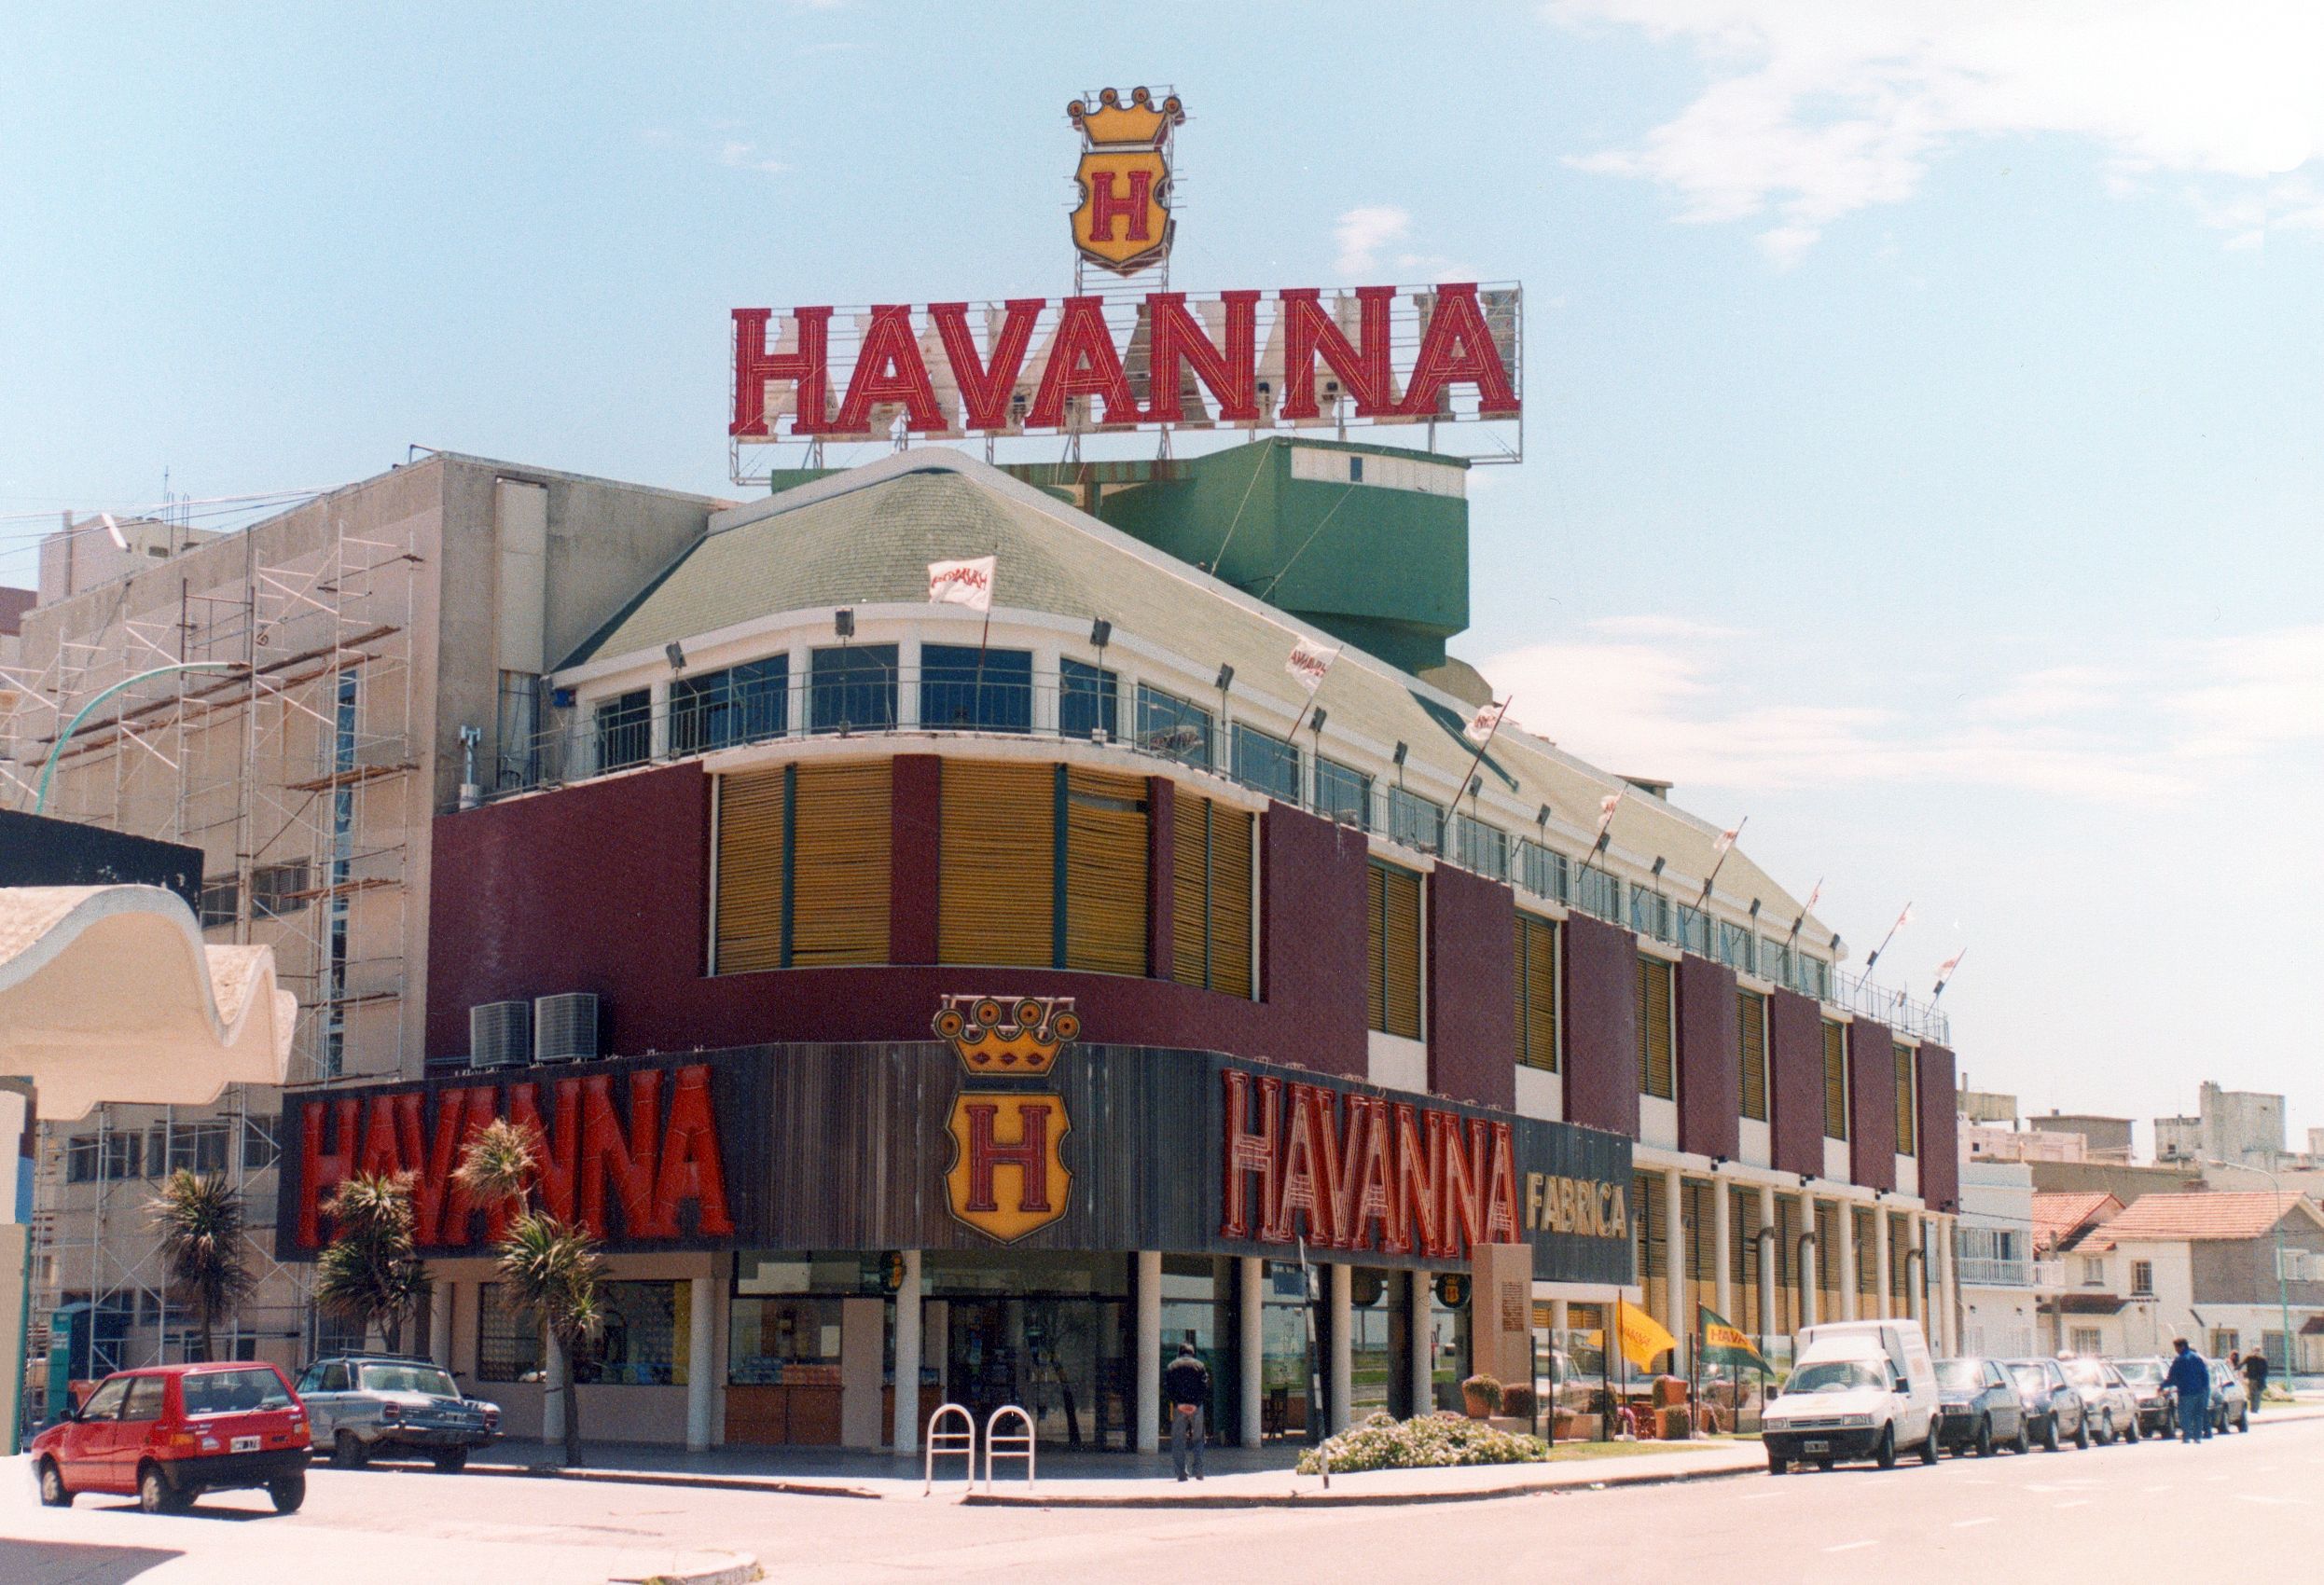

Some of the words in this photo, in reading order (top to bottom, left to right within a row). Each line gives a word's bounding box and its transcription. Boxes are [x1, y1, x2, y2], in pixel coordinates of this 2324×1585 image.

[1090, 171, 1151, 242] H
[729, 283, 1521, 436] HAVANNA
[964, 1104, 1052, 1212] H
[1221, 1068, 1521, 1260] HAVANNA
[1526, 1172, 1626, 1238] FABRICA
